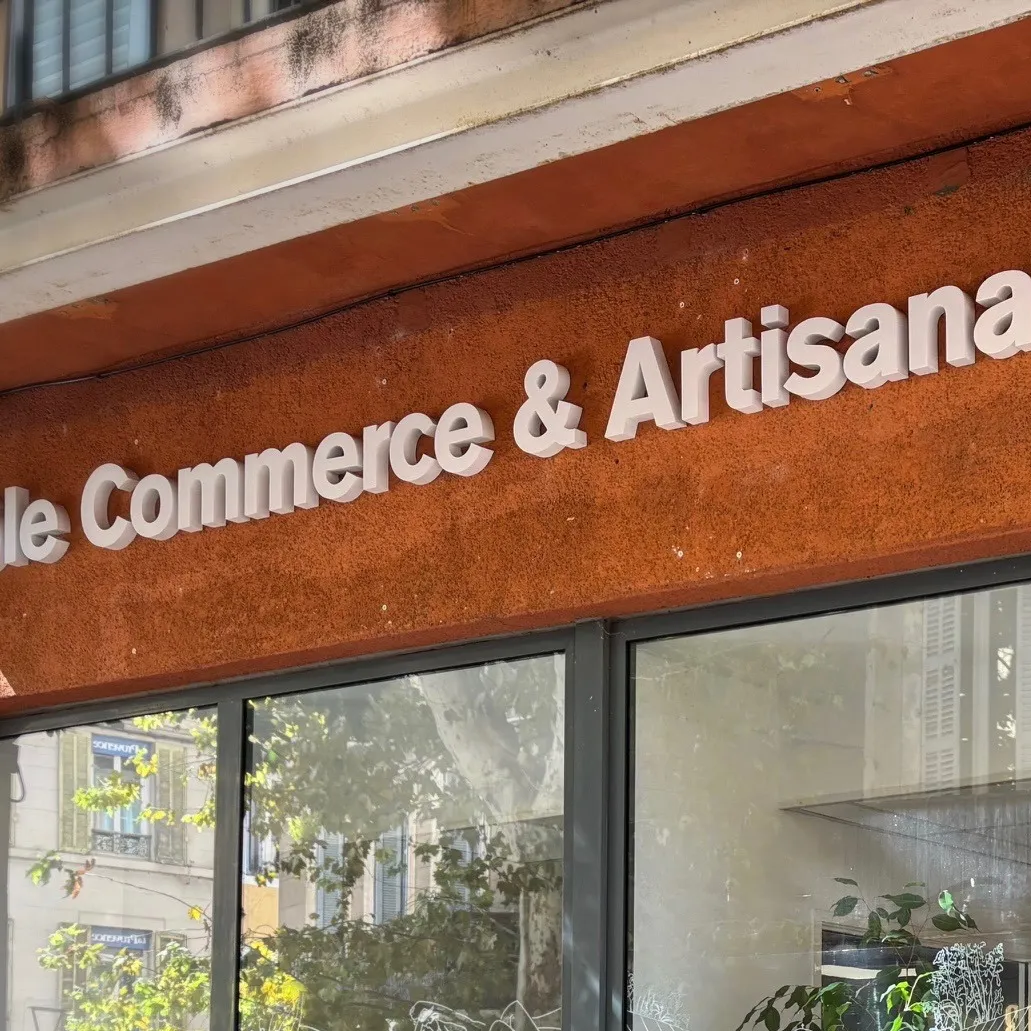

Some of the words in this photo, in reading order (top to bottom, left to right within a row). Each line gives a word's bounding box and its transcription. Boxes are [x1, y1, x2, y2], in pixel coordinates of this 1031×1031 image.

[0, 486, 71, 571] le
[81, 402, 494, 550] Commerce
[513, 359, 587, 458] &
